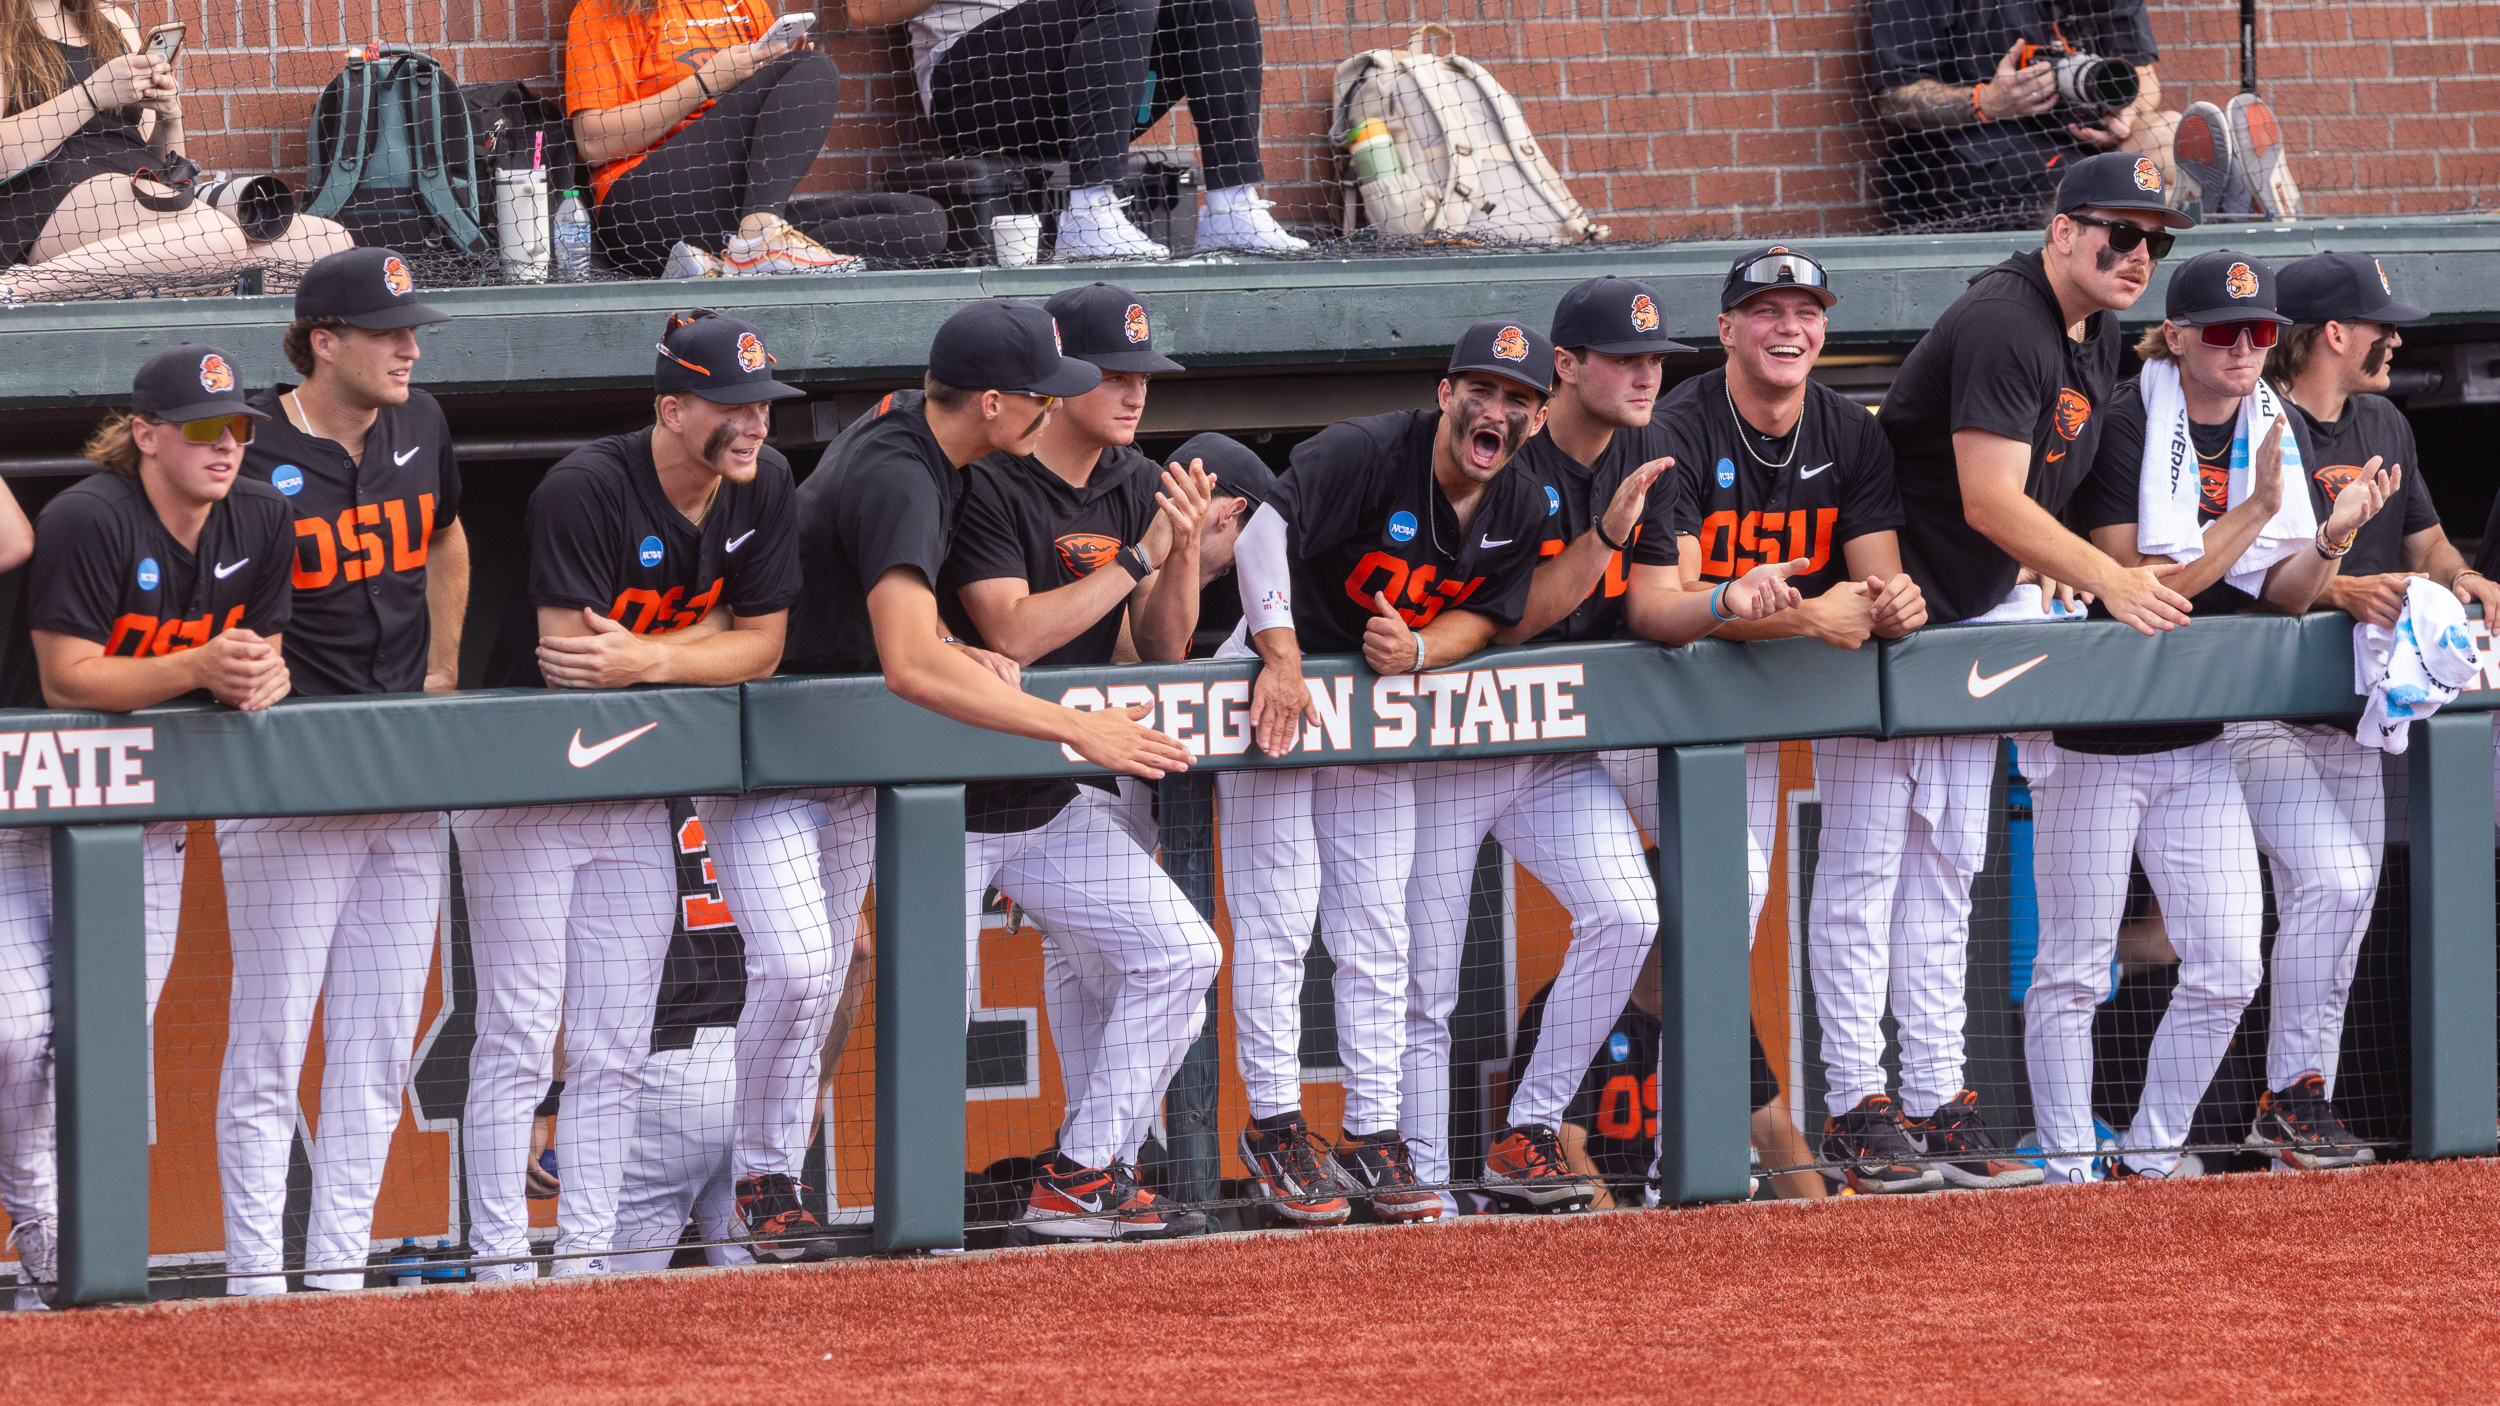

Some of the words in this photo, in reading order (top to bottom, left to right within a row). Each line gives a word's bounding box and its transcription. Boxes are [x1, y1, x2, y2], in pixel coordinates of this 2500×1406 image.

[277, 476, 302, 490] NCAA
[1718, 472, 1734, 481] NCAA
[1391, 523, 1415, 537] NCAA
[291, 493, 435, 589] OSU
[1700, 507, 1839, 577] OSU
[642, 550, 662, 560] NCAA
[1060, 676, 1354, 762] OEGN
[1372, 663, 1586, 749] STATE
